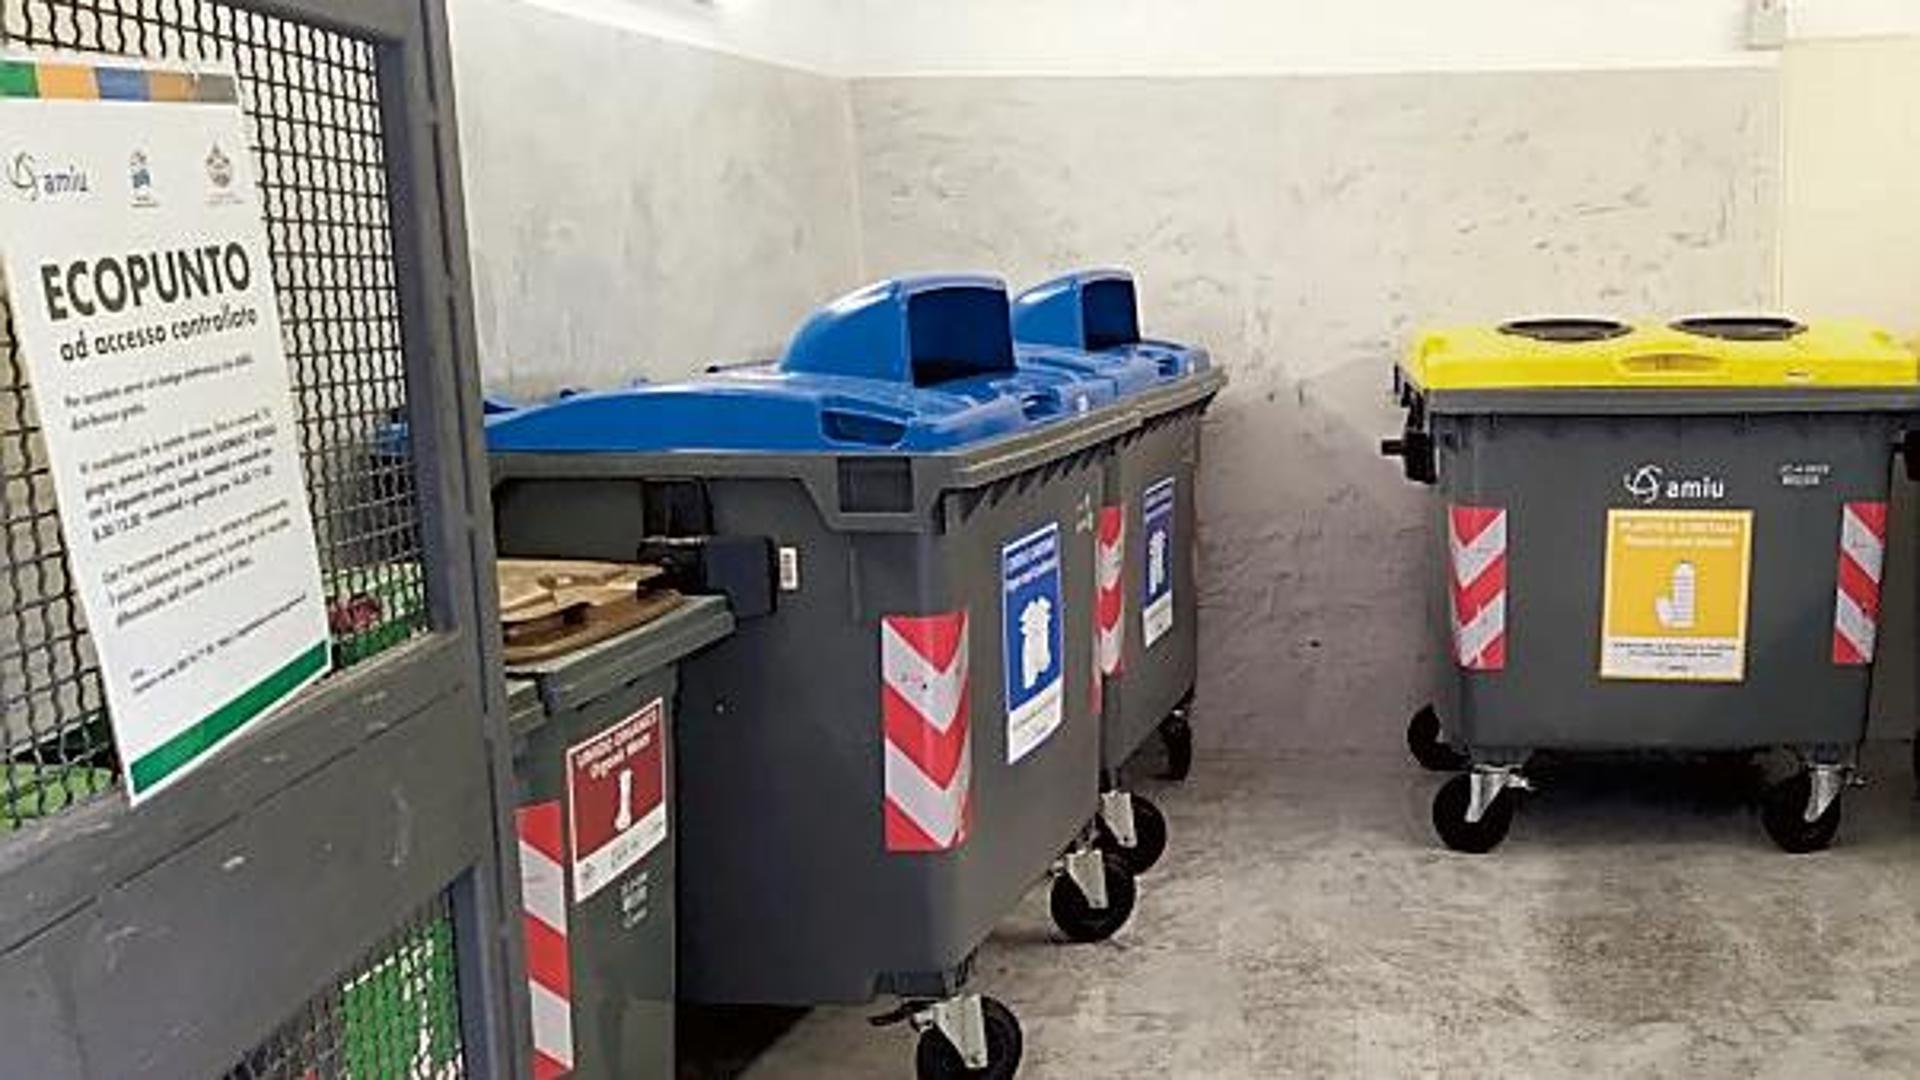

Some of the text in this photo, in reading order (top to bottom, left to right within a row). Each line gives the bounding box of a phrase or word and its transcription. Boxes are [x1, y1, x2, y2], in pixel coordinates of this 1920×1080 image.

[43, 164, 88, 194] amiu
[41, 241, 250, 322] ECOPUNTO
[60, 304, 257, 361] ad accesso controllato
[1666, 476, 1724, 498] amiu
